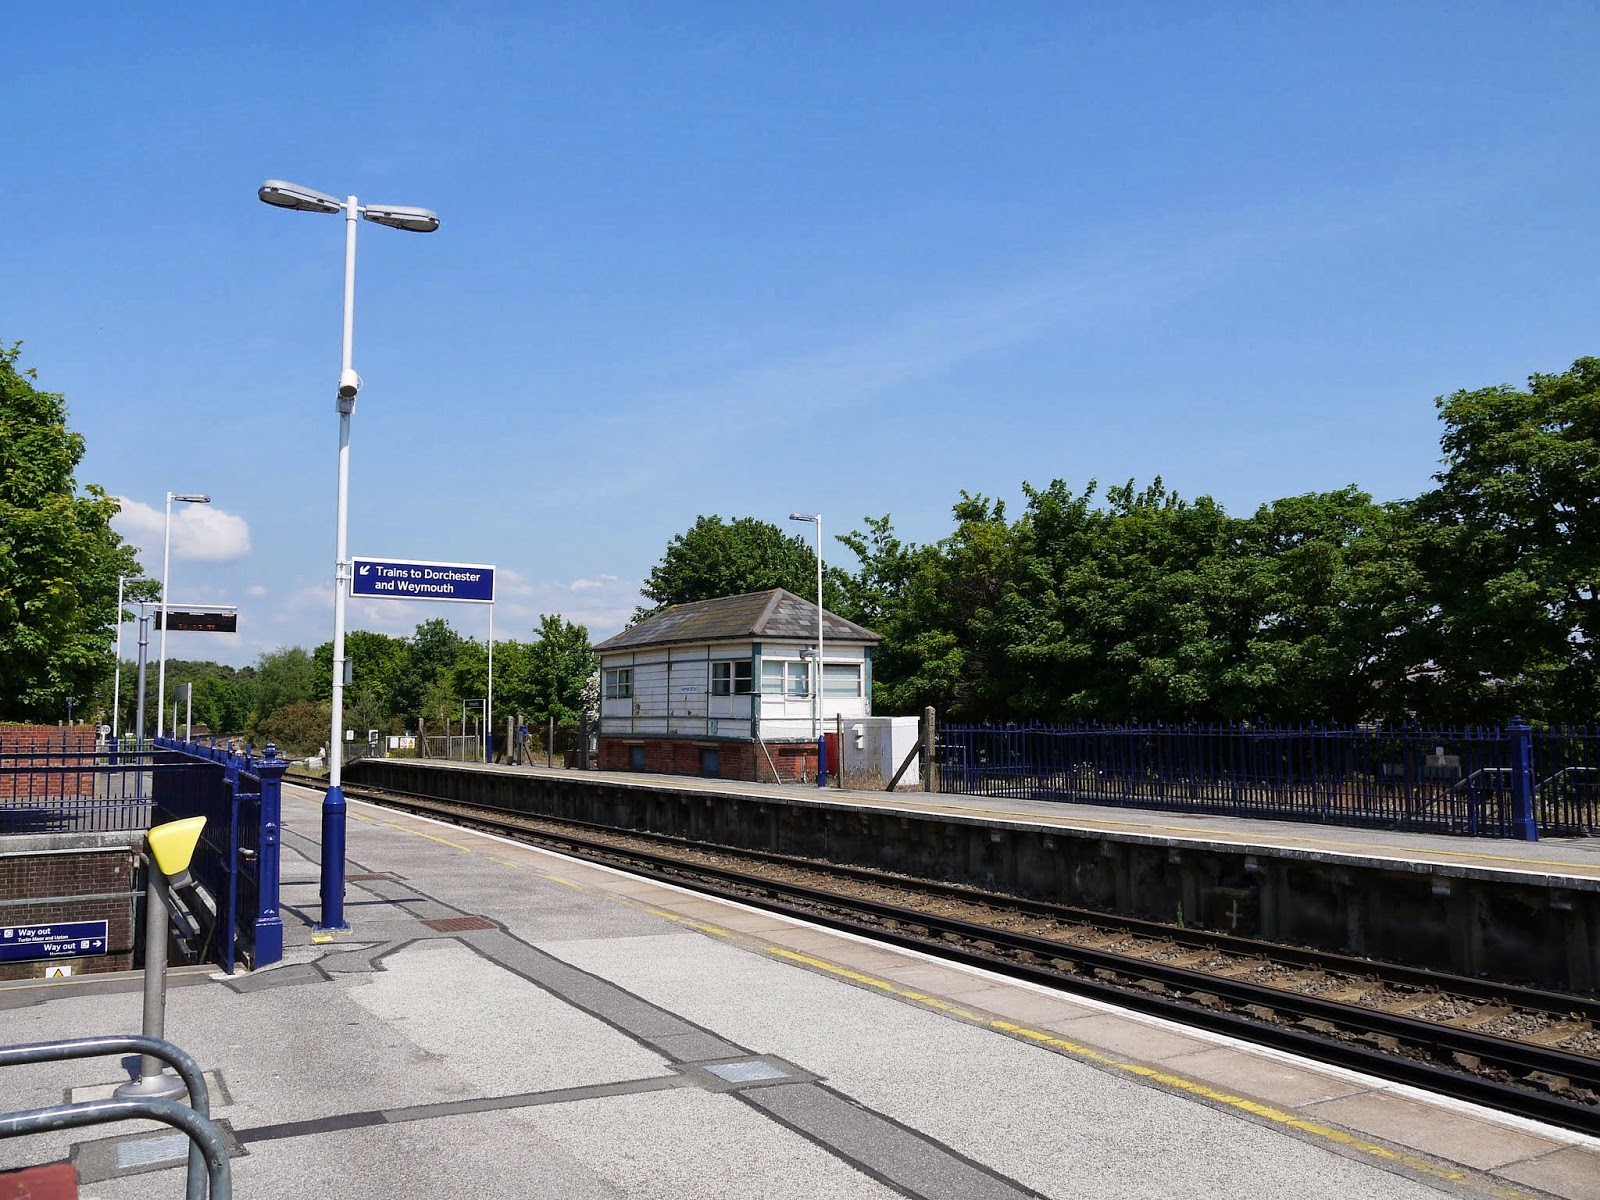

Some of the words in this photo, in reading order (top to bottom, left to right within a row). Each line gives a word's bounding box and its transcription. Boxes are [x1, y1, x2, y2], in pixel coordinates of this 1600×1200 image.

[376, 566, 408, 578] Trains
[410, 568, 422, 579] to
[424, 569, 481, 582] Dorchester
[375, 580, 395, 590] and
[397, 581, 454, 594] Weymouth
[18, 928, 36, 937] Way
[37, 927, 51, 935] out
[43, 943, 61, 952] Way
[62, 942, 76, 950] out
